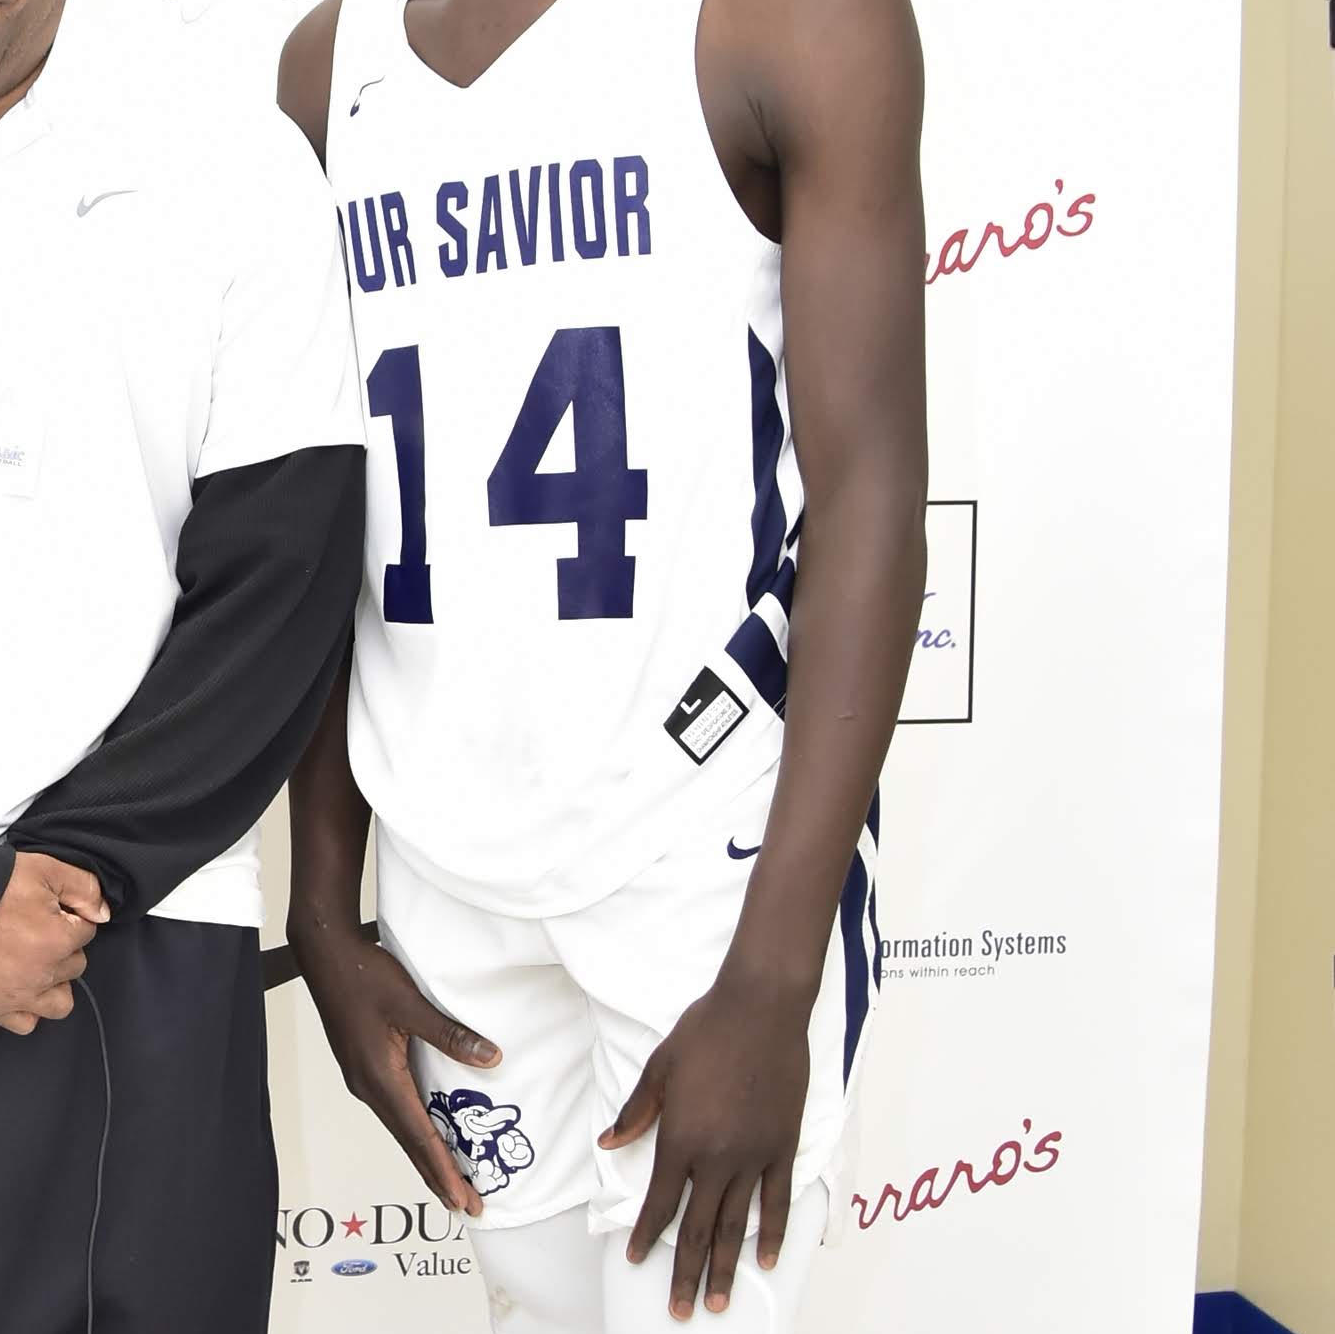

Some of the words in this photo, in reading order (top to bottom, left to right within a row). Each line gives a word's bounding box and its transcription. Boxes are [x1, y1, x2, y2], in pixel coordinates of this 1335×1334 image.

[336, 190, 418, 294] UR
[435, 154, 652, 279] SAVIOR
[366, 325, 648, 625] 14
[679, 699, 702, 715] L
[981, 930, 1067, 962] Systems
[909, 966, 950, 979] within
[954, 964, 996, 977] reach
[393, 1251, 471, 1277] Value
